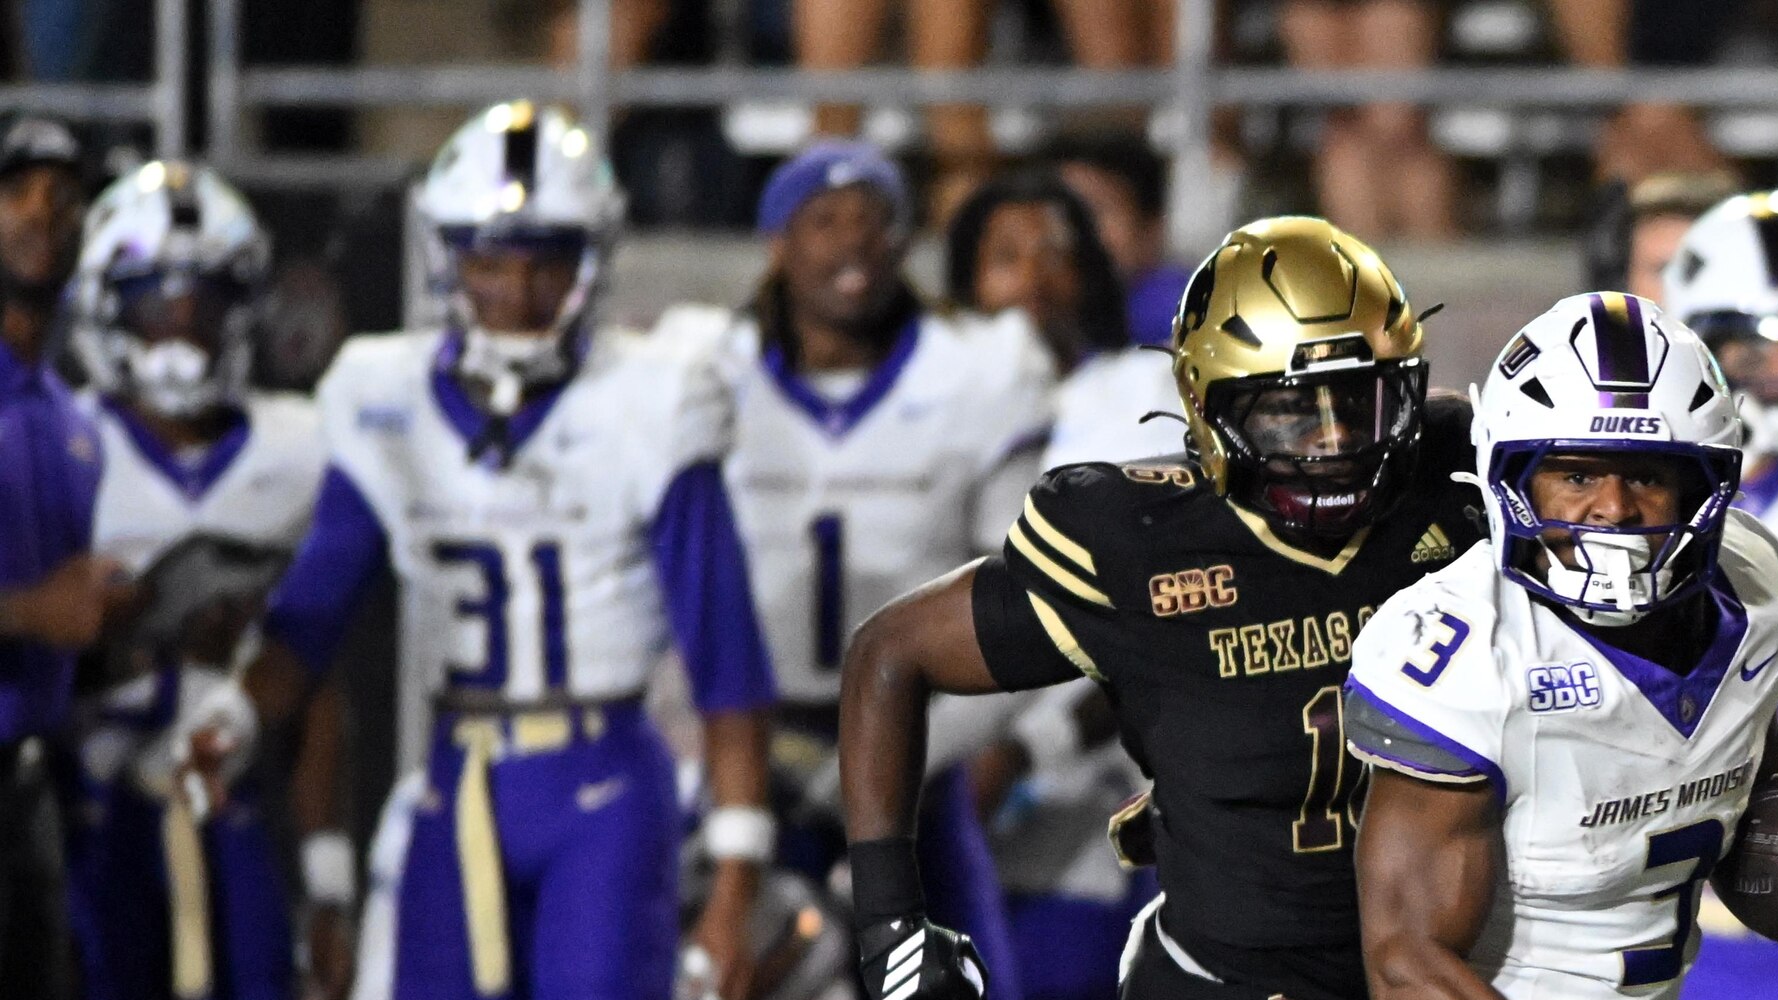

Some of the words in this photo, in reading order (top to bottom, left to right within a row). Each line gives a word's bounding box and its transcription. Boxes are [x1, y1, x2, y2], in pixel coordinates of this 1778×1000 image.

[1589, 416, 1660, 434] DUKES
[430, 540, 568, 688] 31
[808, 513, 847, 671] 1
[1148, 564, 1237, 617] SBC
[1210, 611, 1352, 678] TEXAS
[1400, 612, 1471, 688] 3
[1528, 662, 1600, 712] SBC
[1293, 686, 1364, 853] 1
[1580, 788, 1672, 827] JAMES
[1676, 757, 1754, 809] MADIS
[1622, 817, 1725, 988] 3
